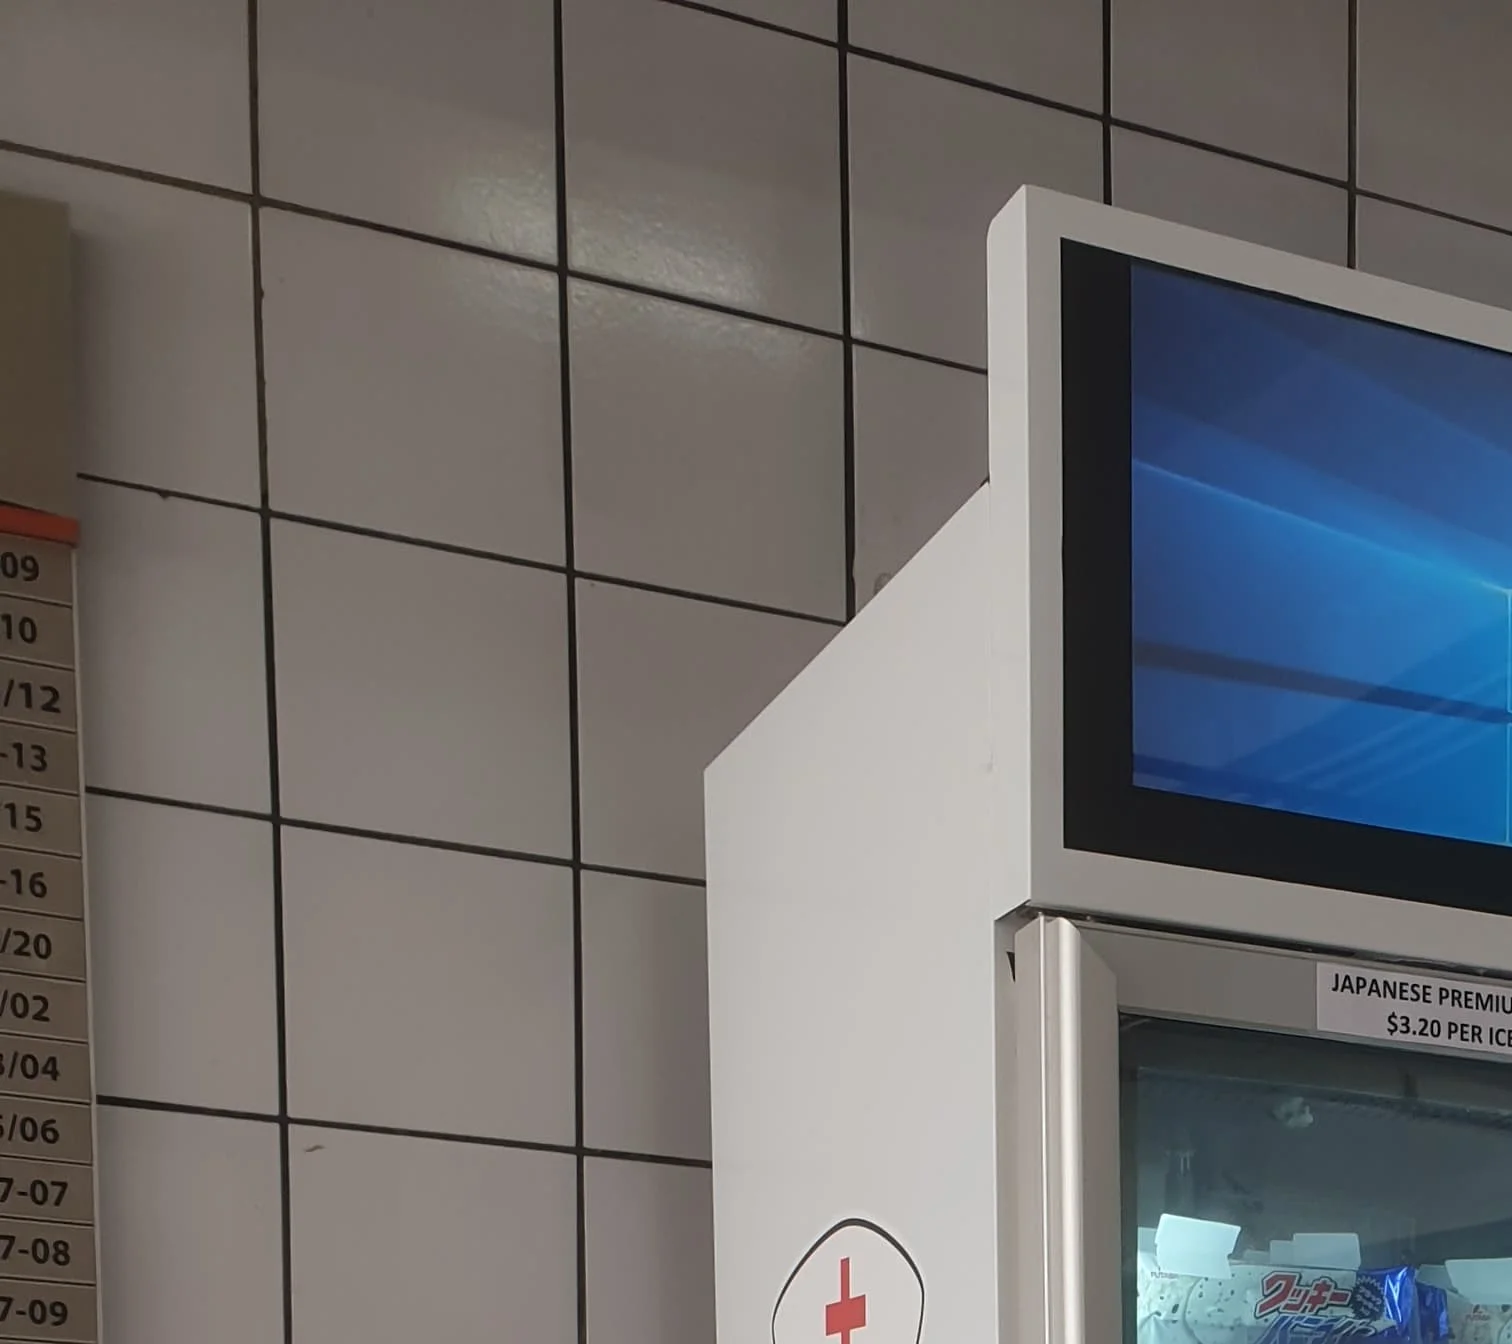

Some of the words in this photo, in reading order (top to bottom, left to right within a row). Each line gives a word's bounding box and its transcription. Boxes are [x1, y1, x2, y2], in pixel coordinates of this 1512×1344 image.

[1331, 972, 1433, 1005] JAPANESE
[1386, 1011, 1442, 1038] $3.20
[1447, 1021, 1483, 1044] PER
[1254, 1271, 1352, 1319] クッキー
